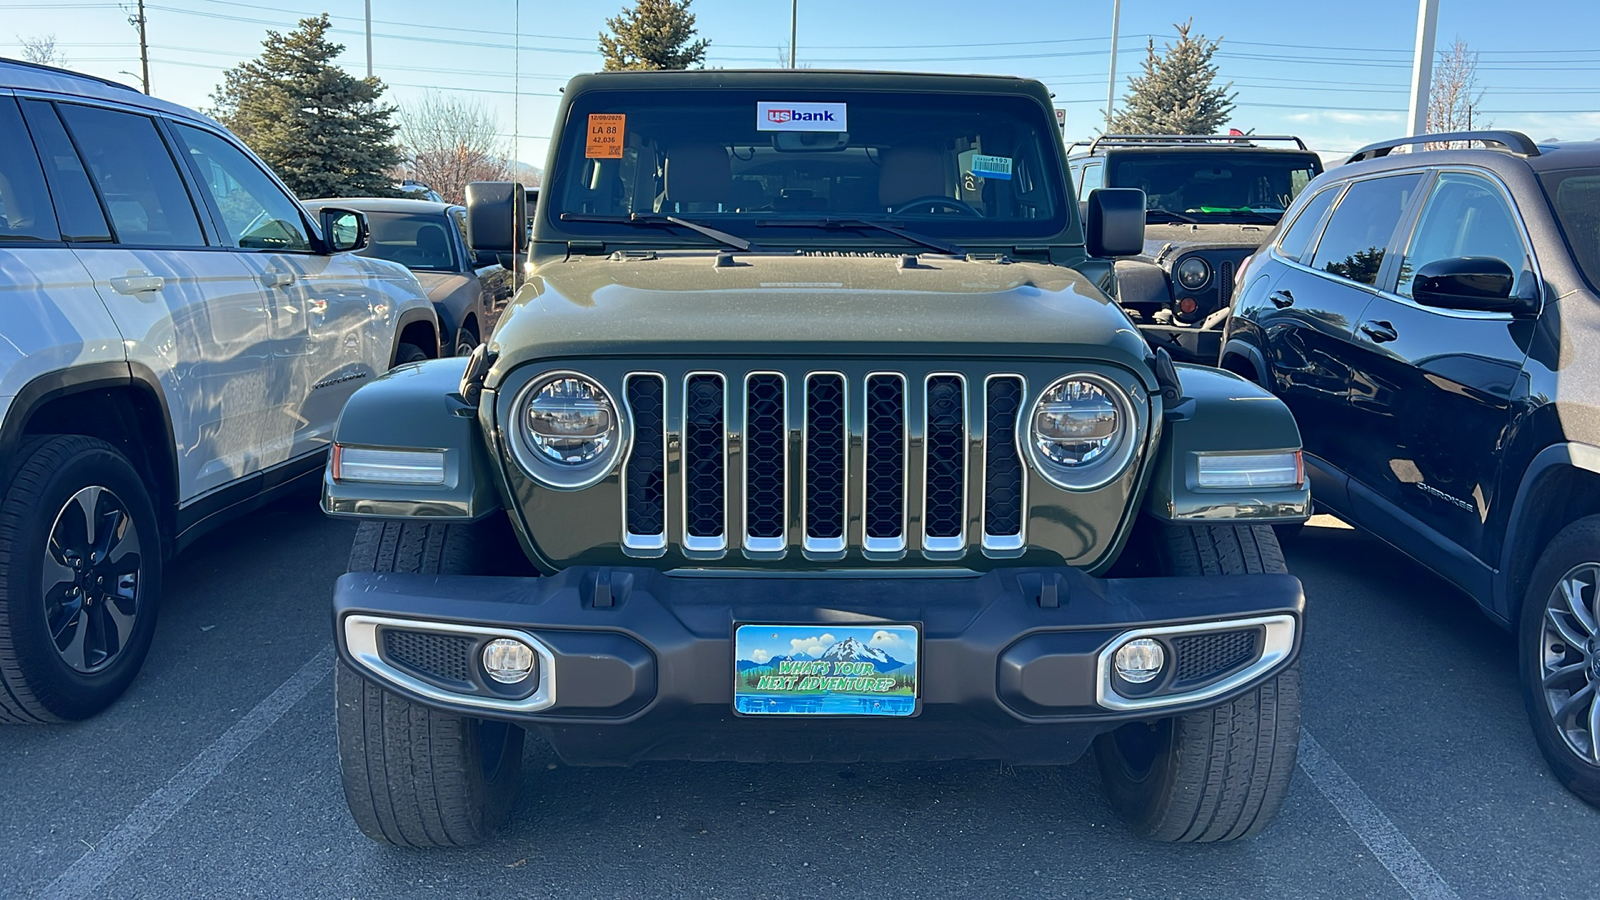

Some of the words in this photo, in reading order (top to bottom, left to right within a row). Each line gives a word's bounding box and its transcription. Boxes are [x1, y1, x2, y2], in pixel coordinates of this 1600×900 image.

[592, 126, 603, 134] LA
[606, 126, 617, 134] 88
[1416, 481, 1474, 513] CHEROKEE
[778, 660, 831, 676] WHAT'S
[833, 661, 875, 676] YOUR
[756, 675, 799, 690] NEXT
[799, 676, 897, 692] ADVENTURE?
